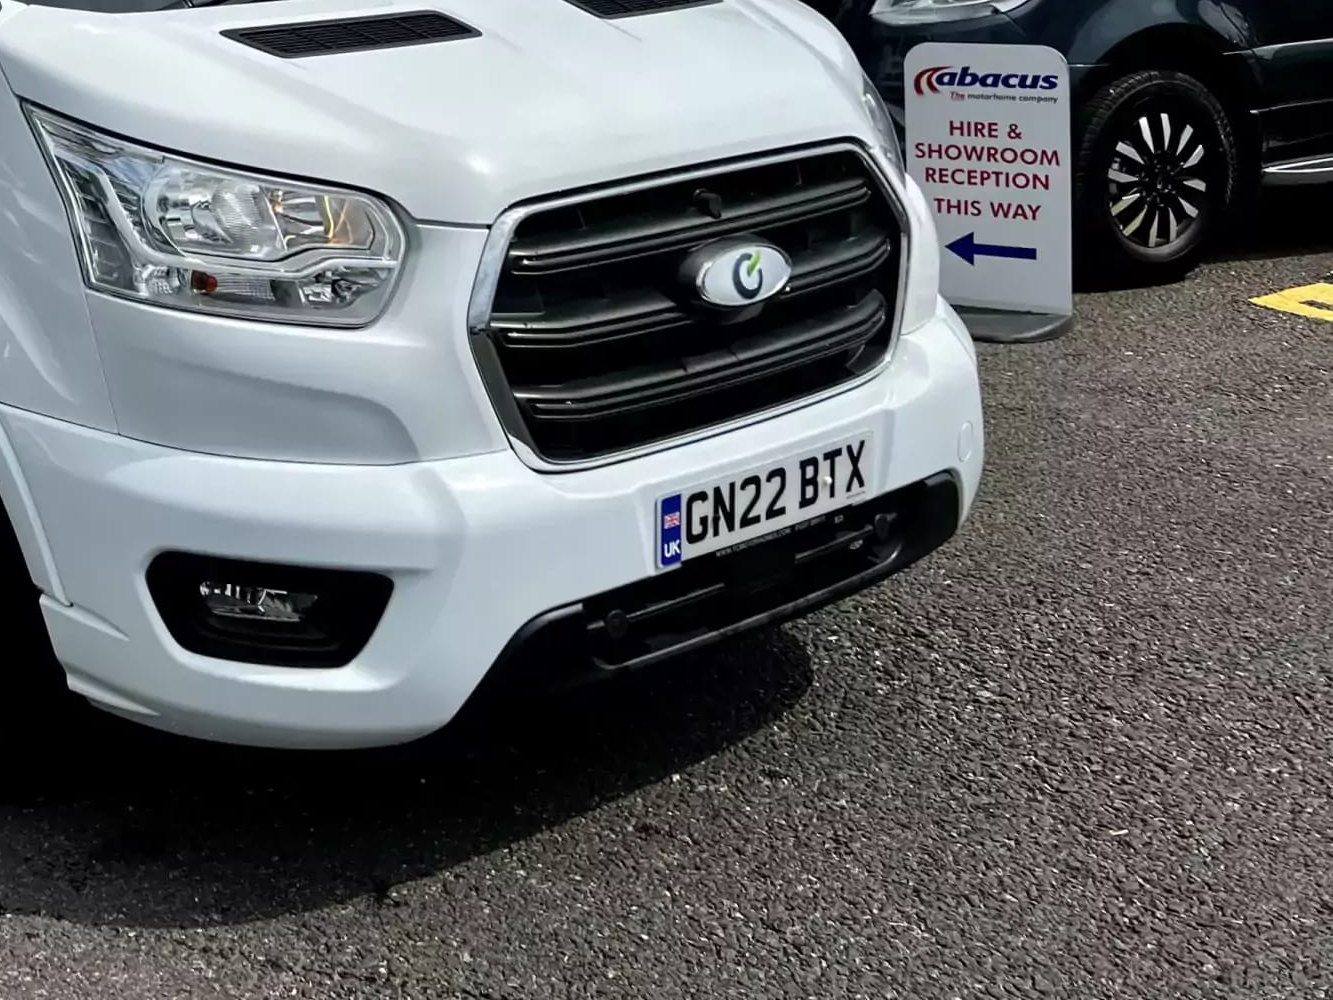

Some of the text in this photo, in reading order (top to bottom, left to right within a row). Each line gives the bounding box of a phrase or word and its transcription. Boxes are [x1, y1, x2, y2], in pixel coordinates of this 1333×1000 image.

[935, 66, 1059, 90] abacus
[950, 91, 1059, 104] The motorhome company
[949, 120, 1022, 139] HIRE &
[914, 142, 1060, 166] SHOWROOM
[924, 167, 1050, 191] RECEPTION
[933, 198, 1042, 221] THIS WAY
[686, 439, 865, 545] GN22 BTX
[664, 540, 680, 557] UK
